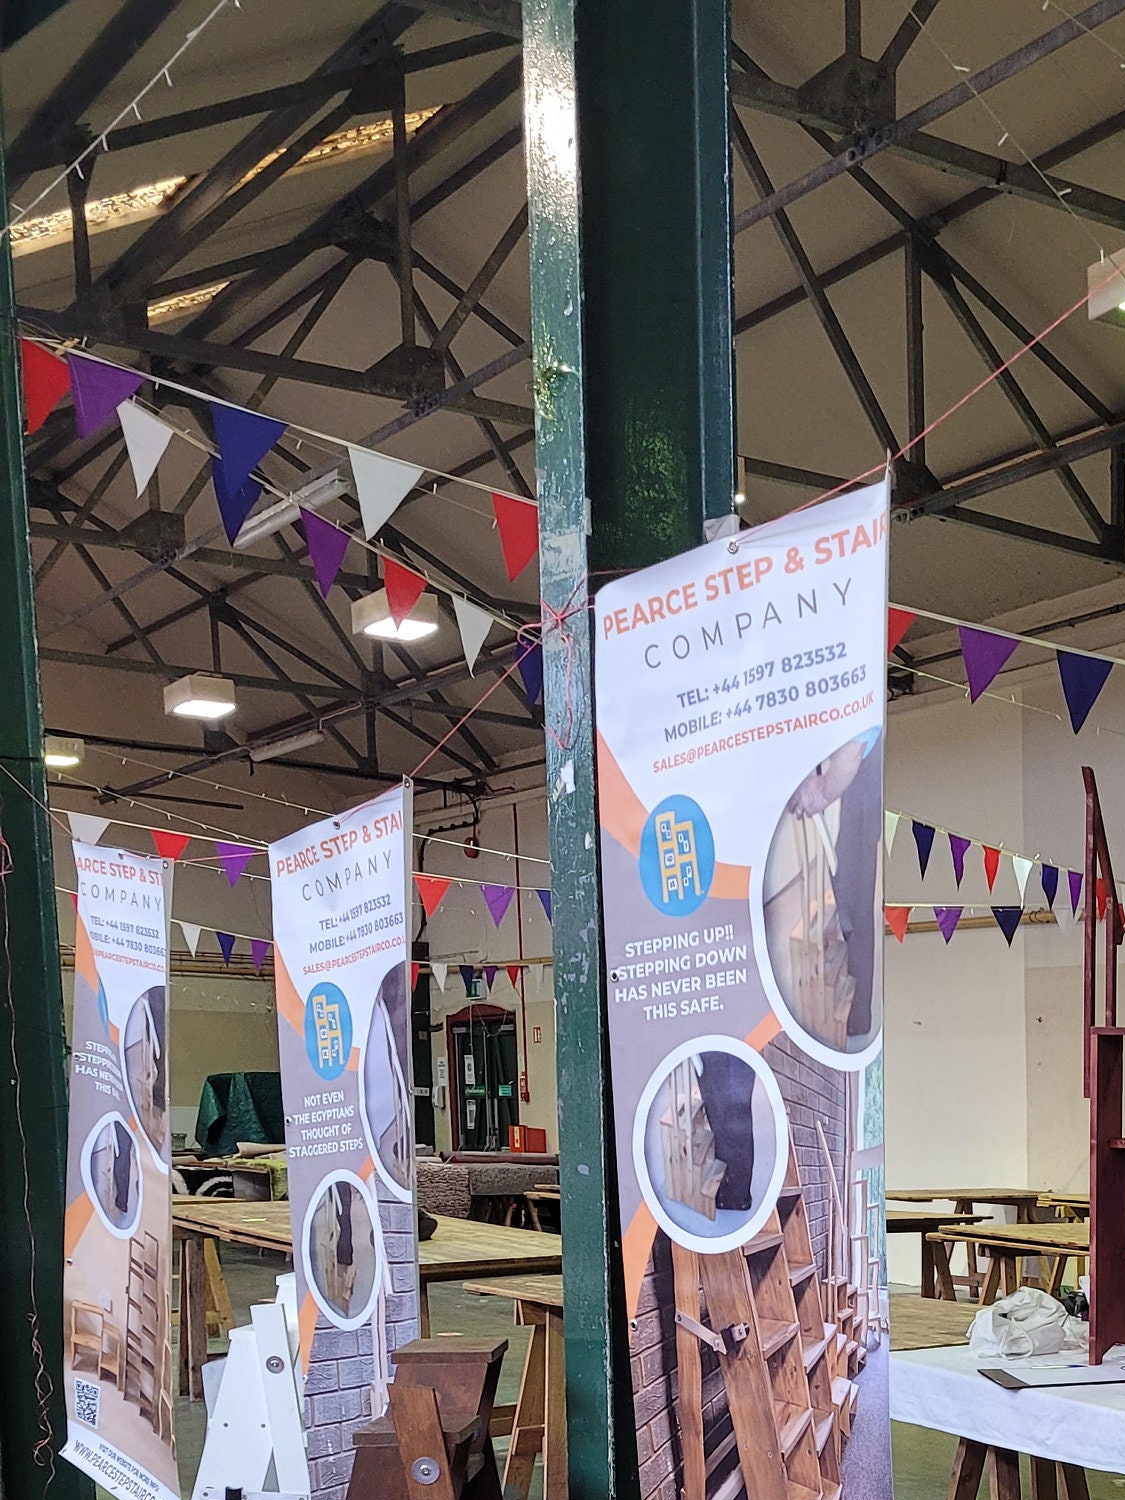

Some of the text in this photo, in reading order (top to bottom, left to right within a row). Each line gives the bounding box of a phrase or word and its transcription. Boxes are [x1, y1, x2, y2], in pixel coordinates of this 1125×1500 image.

[603, 582, 698, 640] PEARCE
[704, 556, 773, 602] STEP
[784, 546, 805, 575] &
[644, 578, 852, 669] COMPANY
[677, 641, 847, 709] TEL: +44 1597 823532
[664, 664, 867, 742] MOBILE: +44 7830 803663
[652, 689, 874, 774] SALES@PEARCESTEPSTAIRCO.CO.UK
[276, 811, 403, 877] PEARCE STEP & STAI
[109, 862, 136, 880] STEP
[302, 850, 392, 901] COMPANY
[80, 881, 162, 912] COMPANY
[319, 915, 338, 931] TEL:
[363, 894, 391, 915] 823532
[90, 915, 105, 926] TEL:
[309, 933, 345, 954] MOBILE:
[374, 912, 404, 932] 803663
[624, 924, 734, 958] STEPPING UP!!
[618, 945, 747, 982] STEPPING DOWN
[615, 968, 748, 1003] HAS NEVER BEEN
[643, 995, 725, 1021] THIS SAFE.
[75, 1064, 98, 1077] HAS
[293, 1105, 354, 1126] THE EGYPTIANS
[304, 1090, 344, 1108] NOT EVEN
[288, 1138, 363, 1158] STAGGERED STEPS
[301, 1123, 352, 1141] THOUGHT OF
